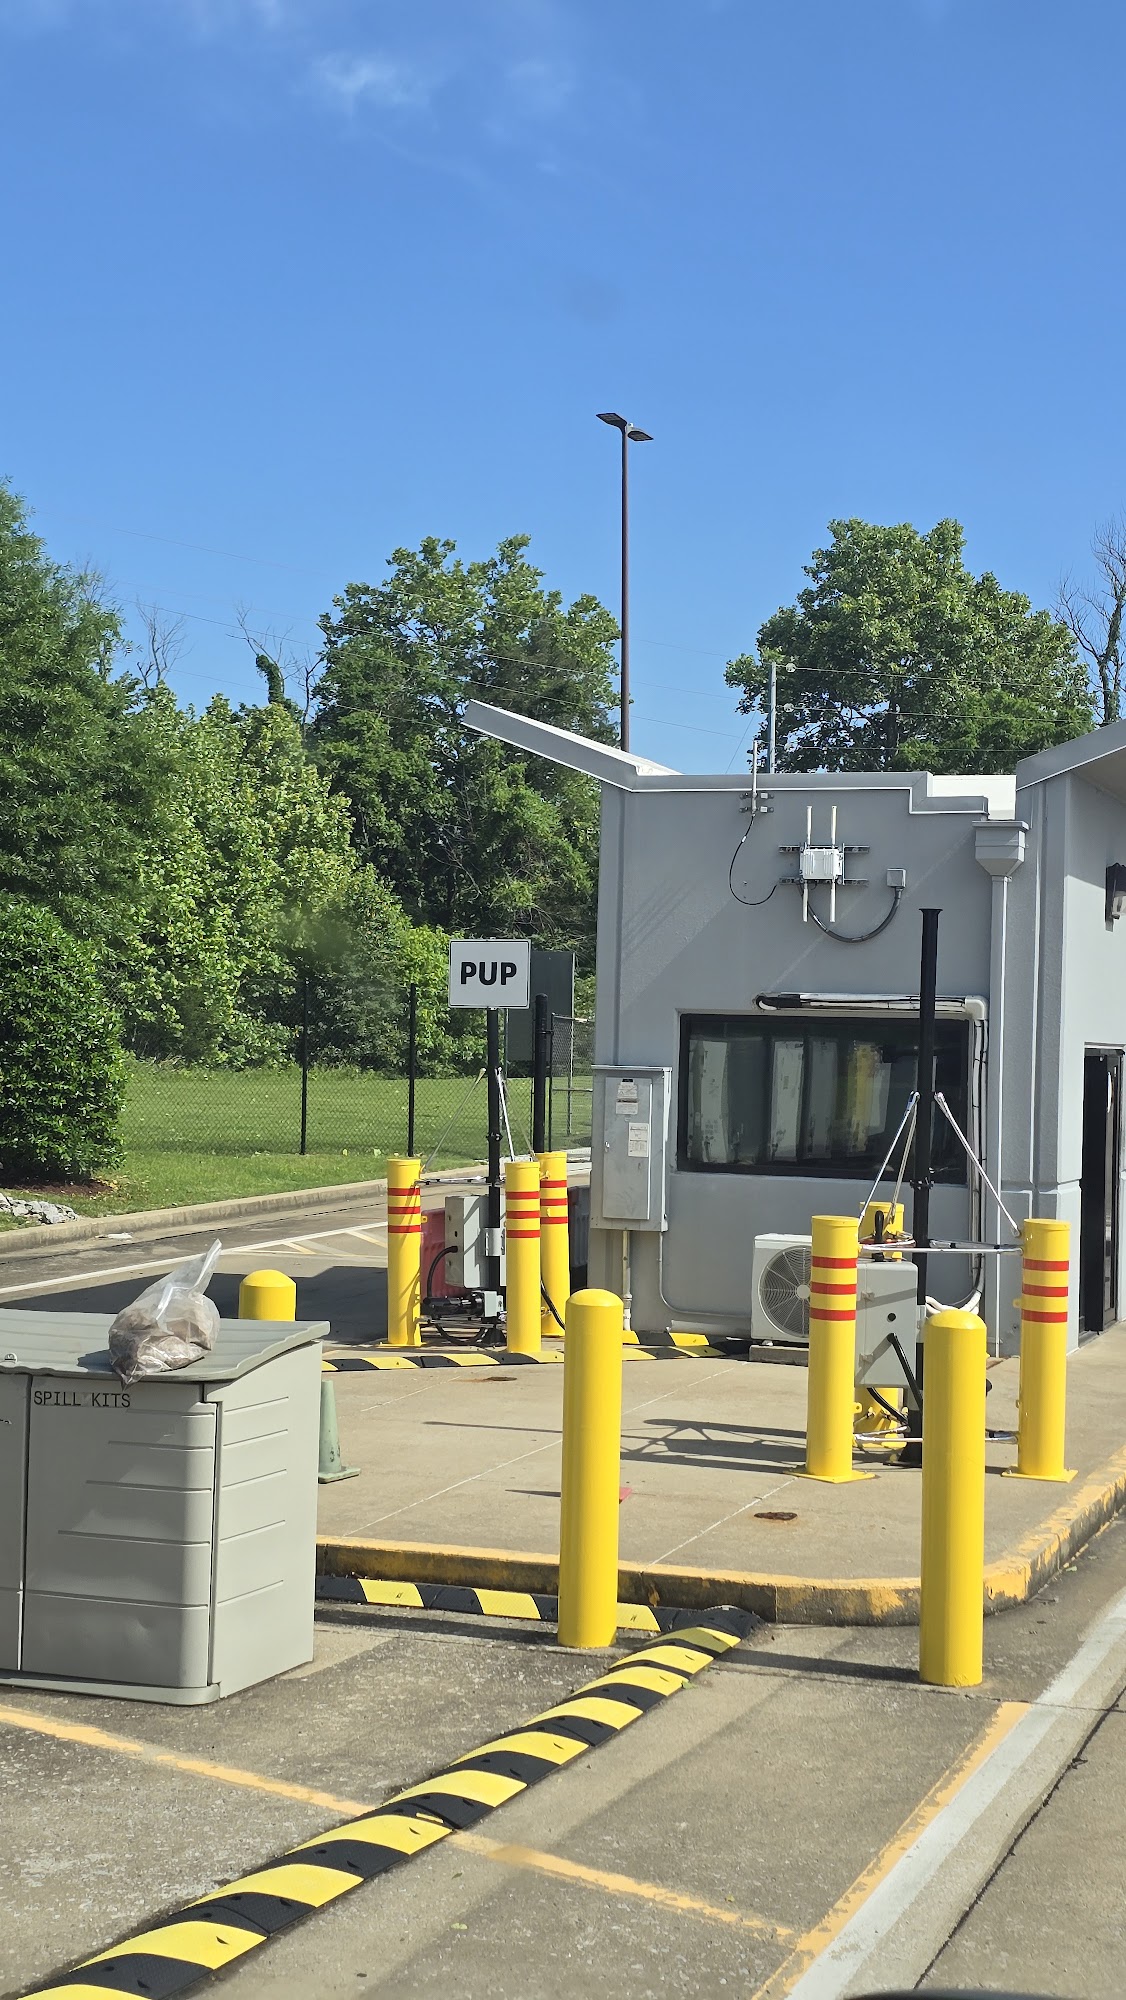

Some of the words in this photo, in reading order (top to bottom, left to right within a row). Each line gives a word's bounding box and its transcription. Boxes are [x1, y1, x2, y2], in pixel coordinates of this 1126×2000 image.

[460, 961, 517, 986] PUP
[33, 1390, 82, 1407] SPILL
[91, 1392, 131, 1408] KITS
